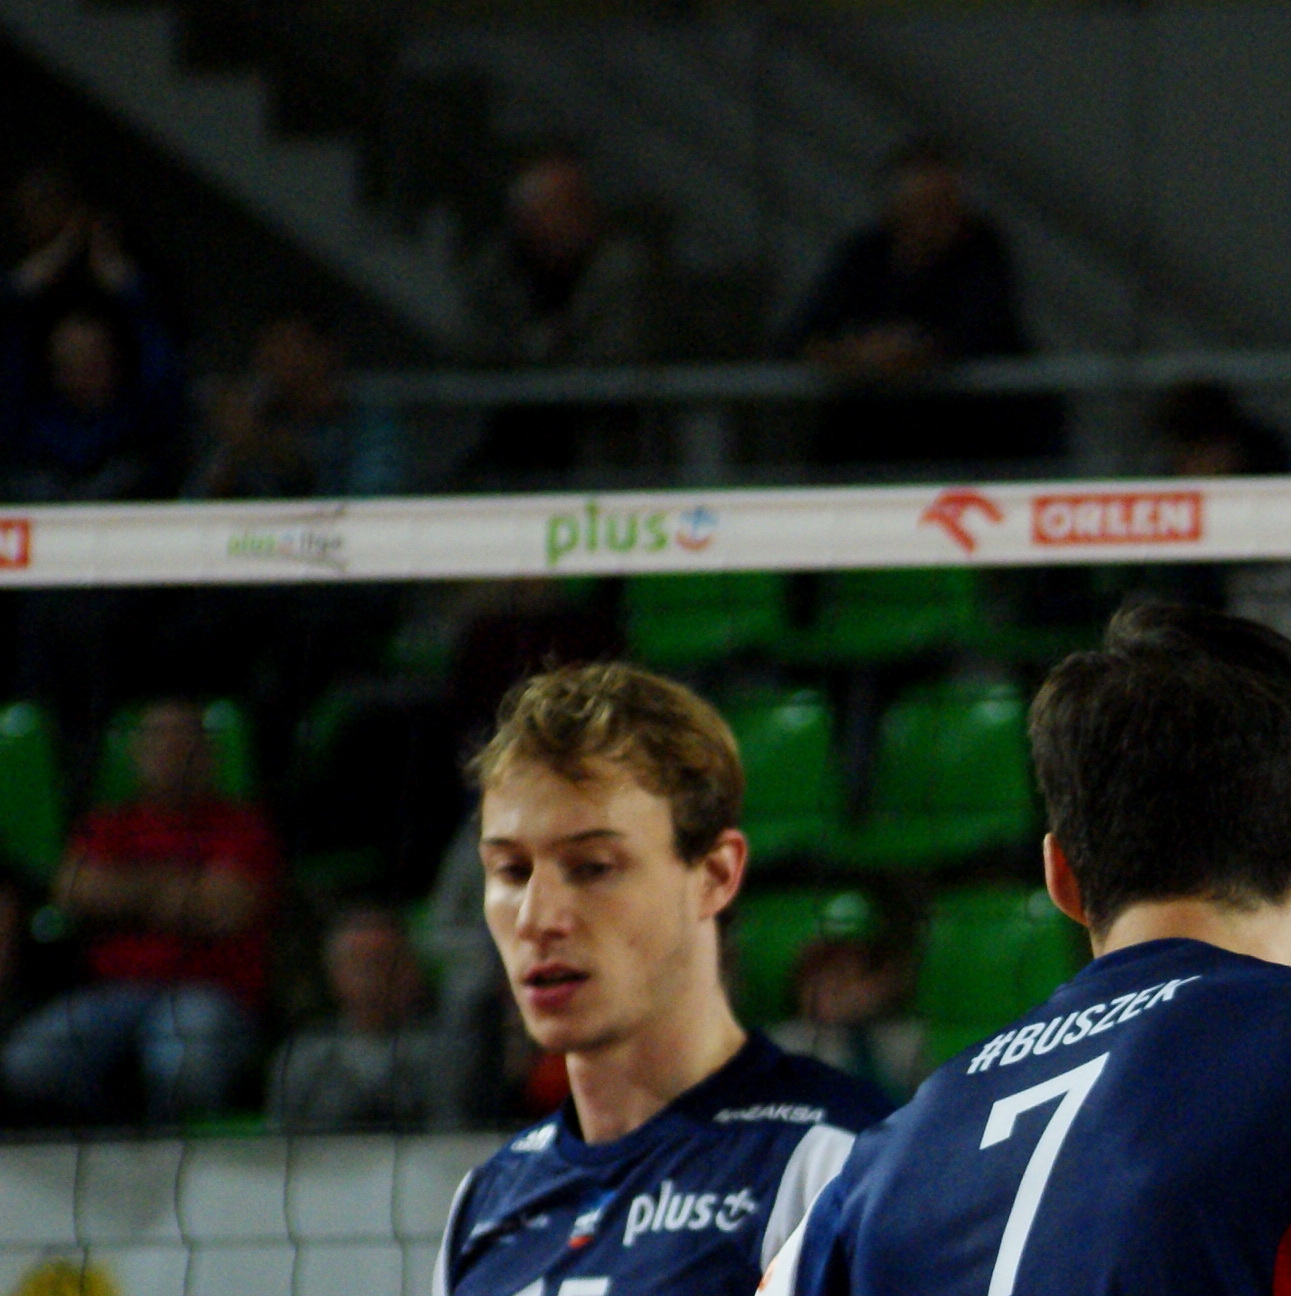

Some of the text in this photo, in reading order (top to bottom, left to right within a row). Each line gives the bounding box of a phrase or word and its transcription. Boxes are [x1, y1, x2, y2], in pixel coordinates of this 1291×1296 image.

[545, 498, 669, 567] plus
[1039, 498, 1191, 542] ORLEN
[966, 975, 1201, 1075] #BUSZEK
[622, 1180, 716, 1247] plus
